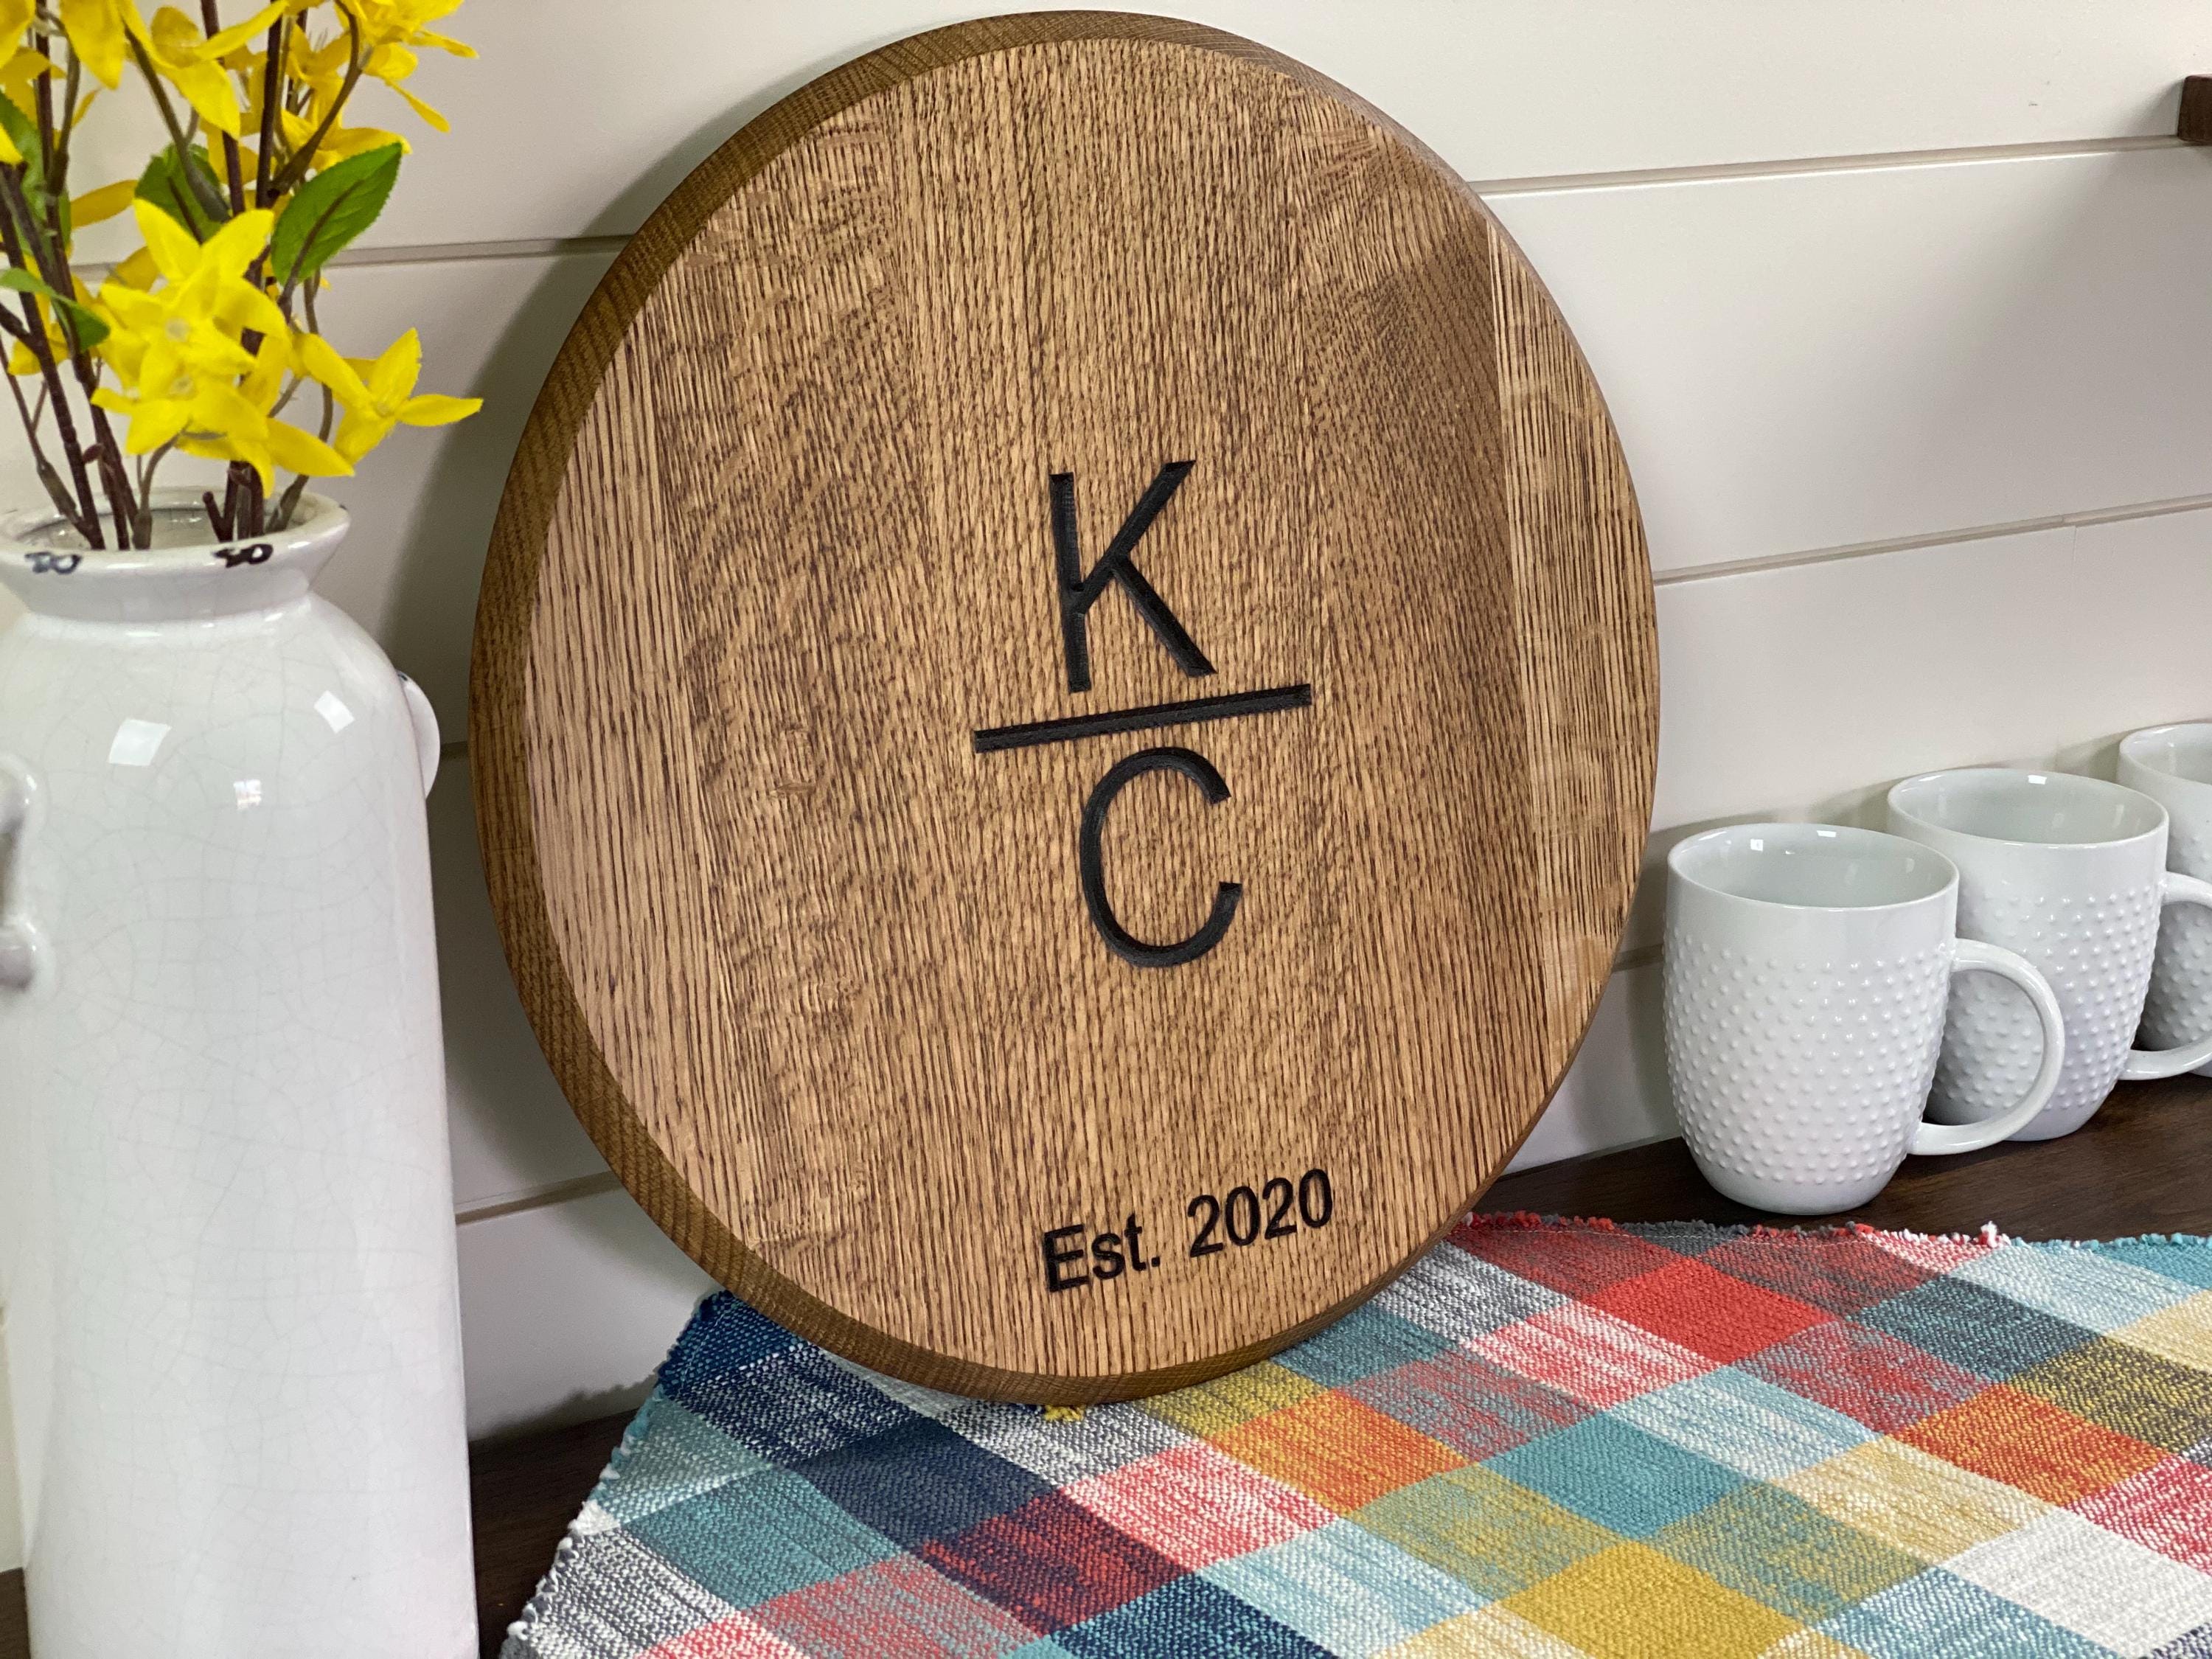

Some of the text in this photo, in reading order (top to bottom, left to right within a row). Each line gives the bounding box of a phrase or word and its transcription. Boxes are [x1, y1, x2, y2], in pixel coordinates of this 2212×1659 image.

[1048, 459, 1217, 694] K
[1079, 745, 1243, 968] C
[1042, 1168, 1333, 1293] Est. 2020
